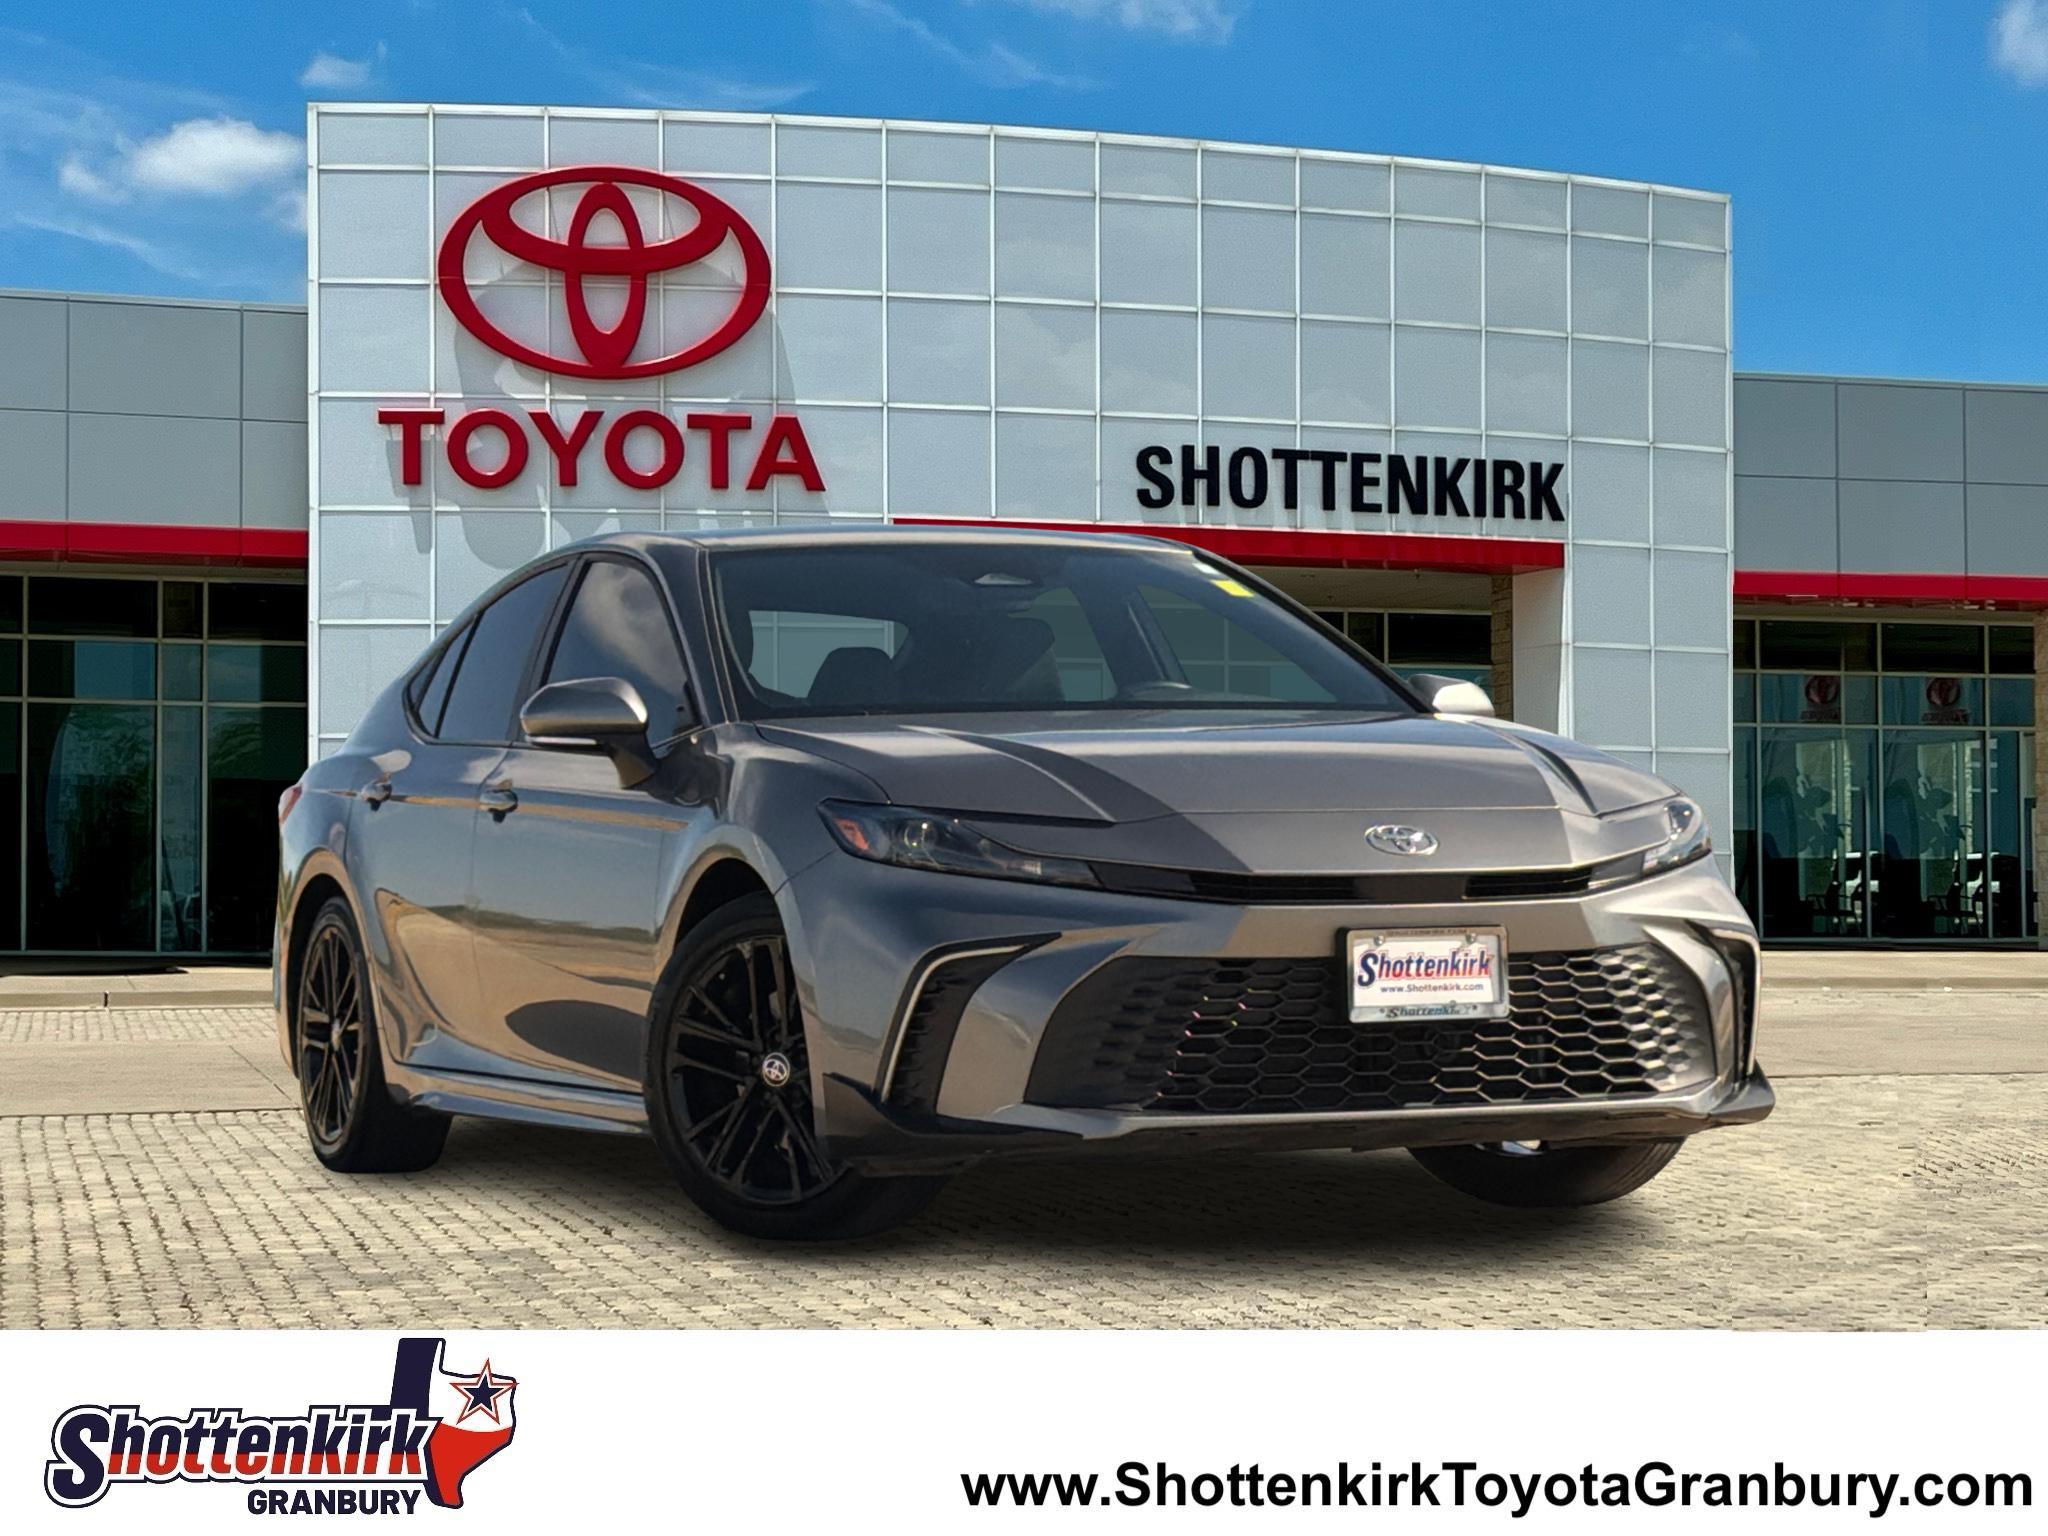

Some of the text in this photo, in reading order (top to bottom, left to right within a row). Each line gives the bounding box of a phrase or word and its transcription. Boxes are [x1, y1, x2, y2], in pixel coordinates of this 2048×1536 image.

[378, 407, 826, 491] TOYOTA
[1136, 444, 1565, 522] SHOTTENKIRK
[1356, 949, 1491, 987] Shottenkirk
[1380, 983, 1484, 993] www.Shottenkirk.com
